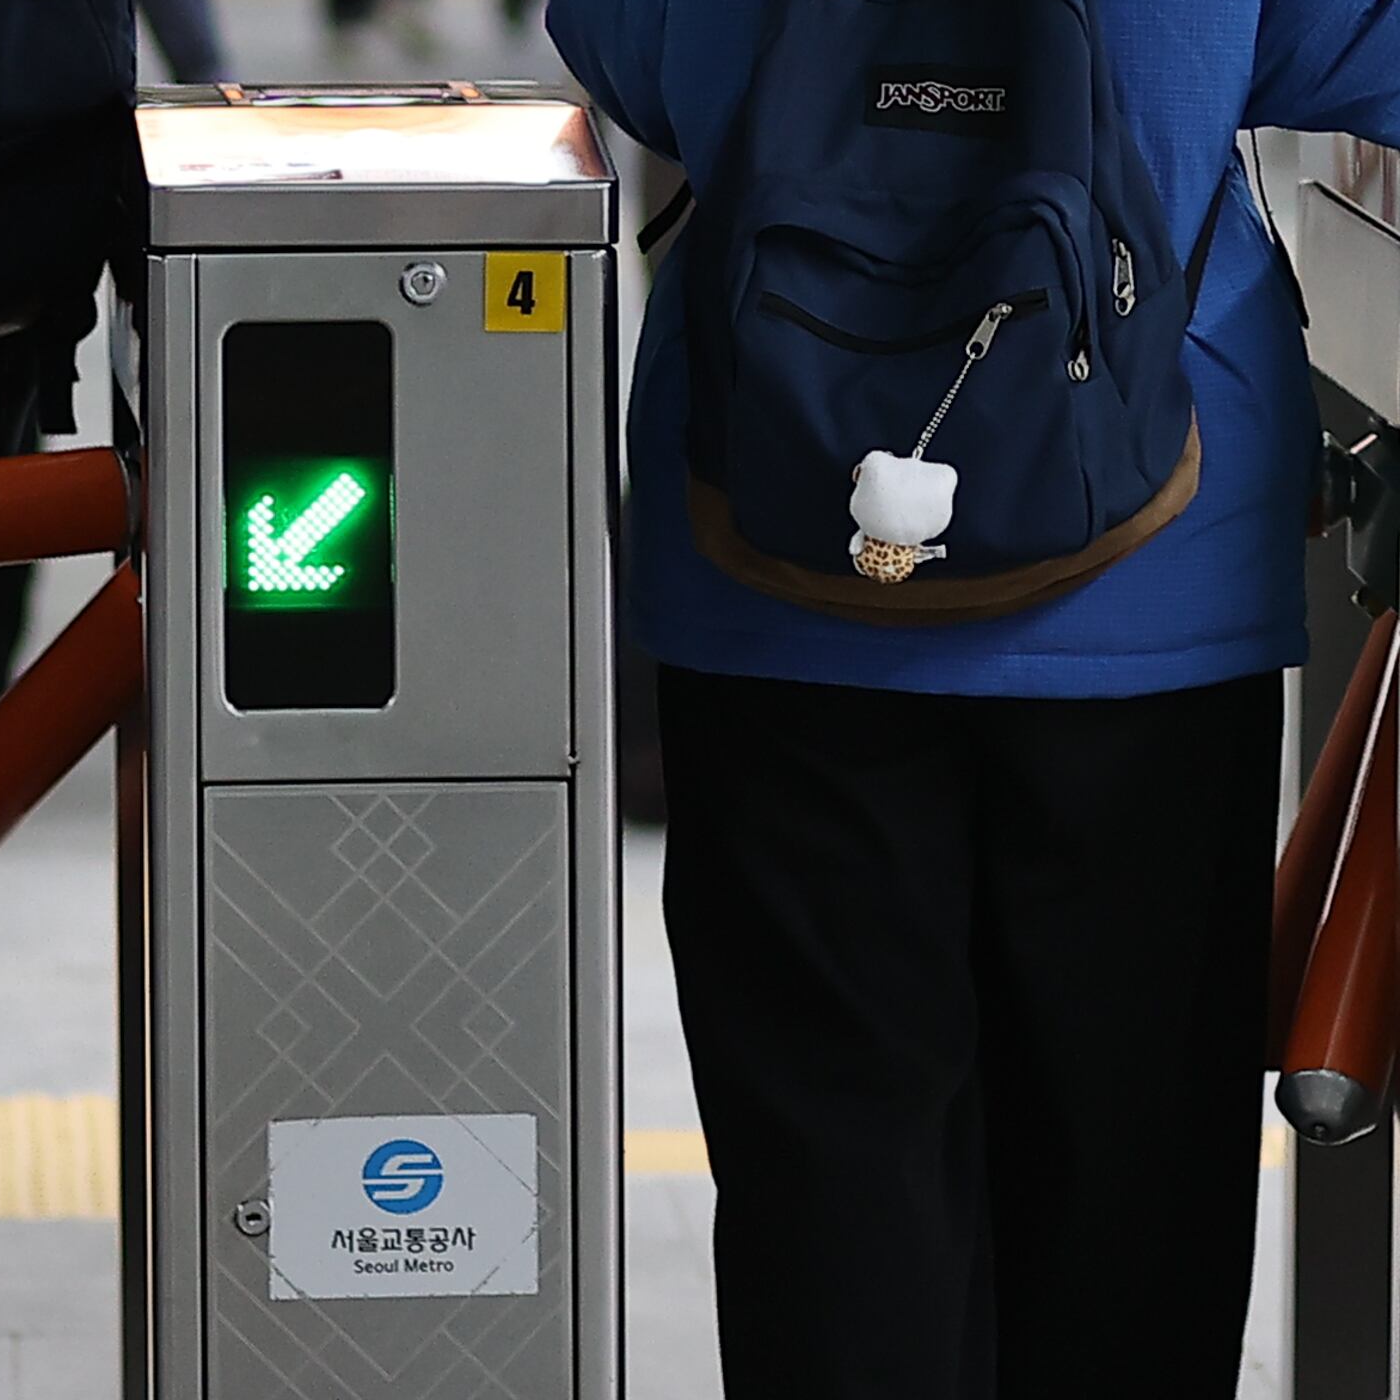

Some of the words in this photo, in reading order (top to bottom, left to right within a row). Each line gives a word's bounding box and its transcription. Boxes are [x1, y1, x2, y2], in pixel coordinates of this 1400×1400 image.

[876, 81, 1005, 113] JANSPORT
[507, 270, 536, 315] 4
[331, 1226, 477, 1253] 서울교통공사
[354, 1259, 399, 1274] Seoul
[404, 1259, 454, 1273] Metro
